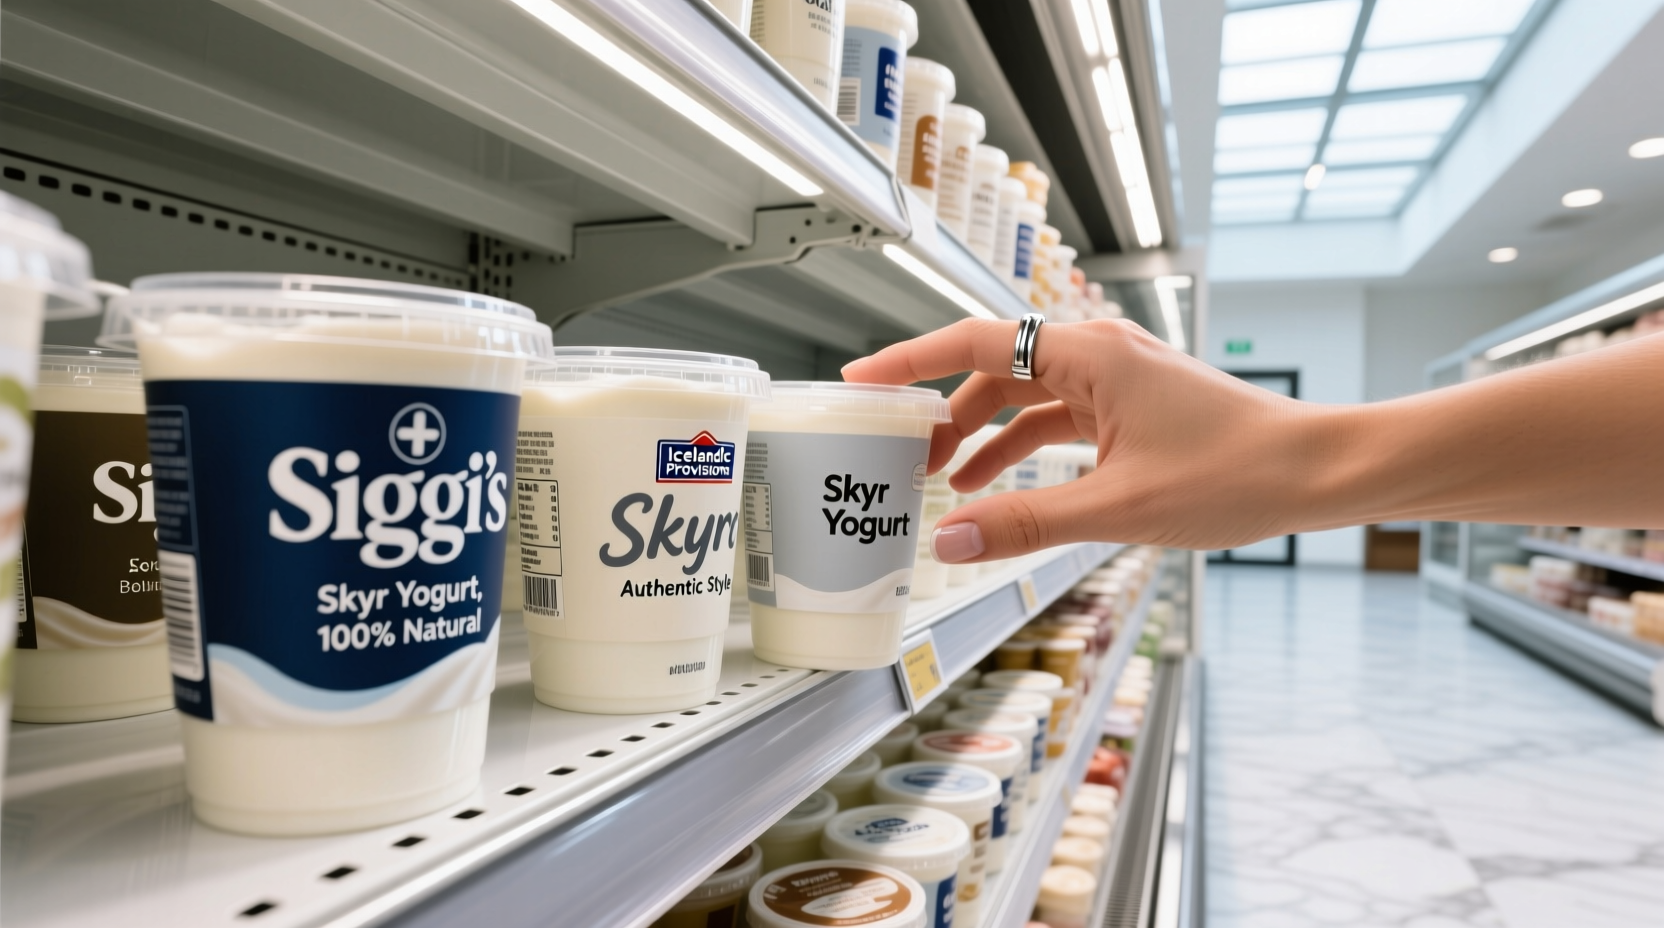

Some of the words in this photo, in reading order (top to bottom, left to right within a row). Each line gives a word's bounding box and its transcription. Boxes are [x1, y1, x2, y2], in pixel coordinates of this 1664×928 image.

[92, 460, 158, 526] Si
[268, 446, 507, 569] Siggi's
[823, 473, 890, 511] Skyr
[822, 508, 910, 544] Yogurt
[317, 583, 389, 620] Skyr
[395, 574, 483, 620] Yogurt,
[620, 578, 703, 598] Authentic
[707, 573, 731, 596] Style
[317, 622, 396, 653] 100%
[402, 610, 482, 645] Natural
